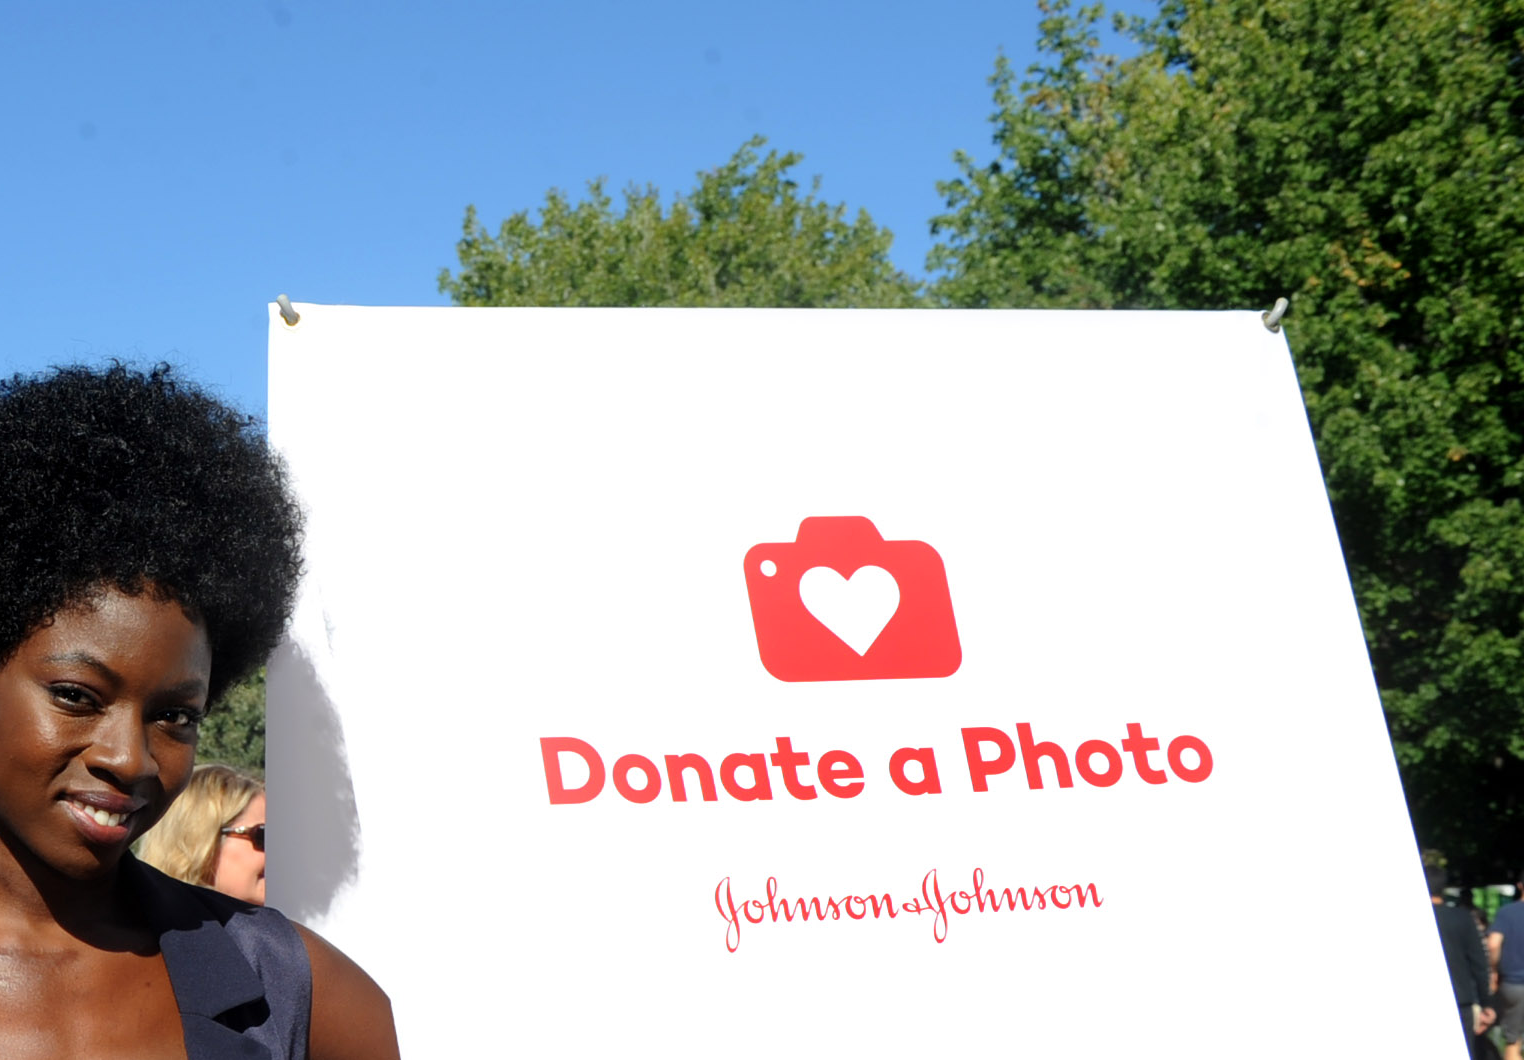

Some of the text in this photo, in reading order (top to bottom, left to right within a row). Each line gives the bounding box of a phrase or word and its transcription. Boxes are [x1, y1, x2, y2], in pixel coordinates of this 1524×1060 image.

[539, 722, 1214, 805] Donate a Photo
[714, 876, 899, 954] Johnson
[921, 867, 1105, 944] Johnson
